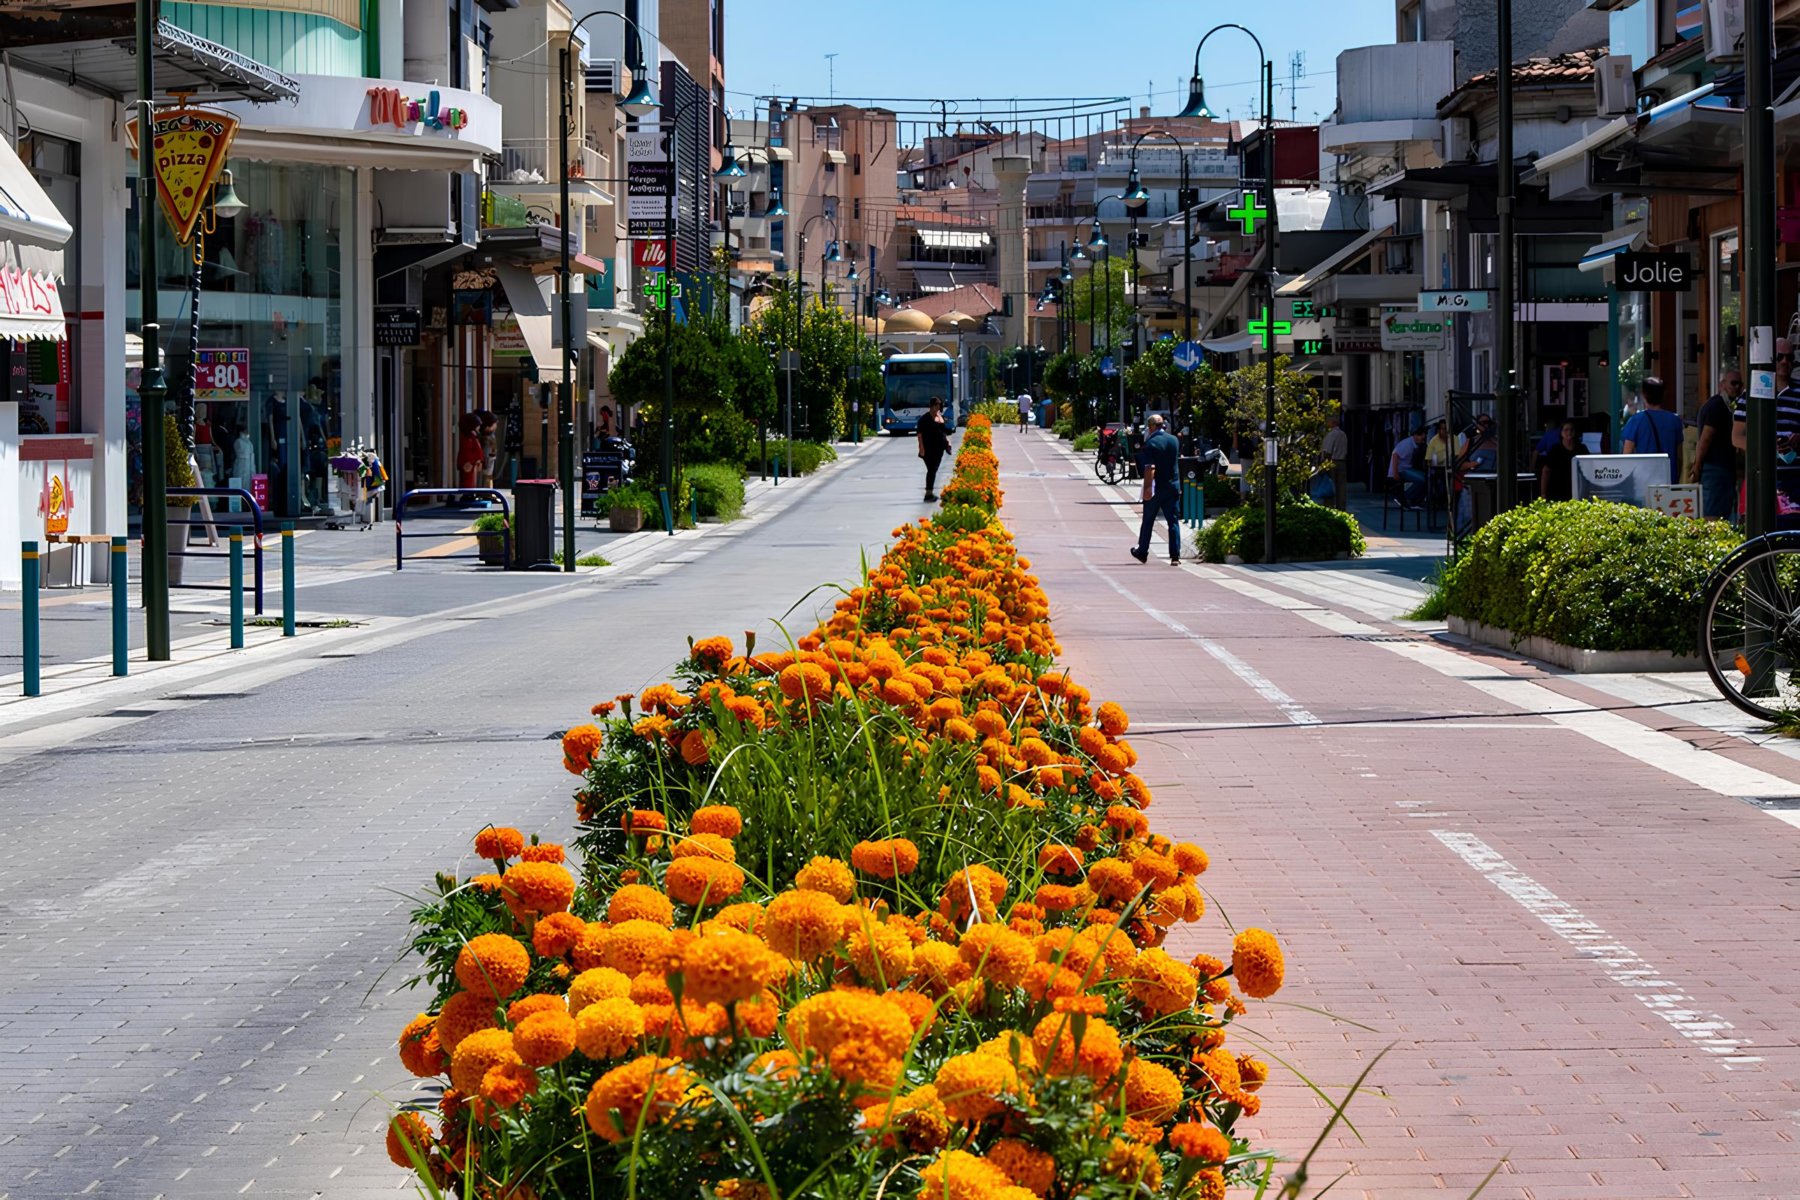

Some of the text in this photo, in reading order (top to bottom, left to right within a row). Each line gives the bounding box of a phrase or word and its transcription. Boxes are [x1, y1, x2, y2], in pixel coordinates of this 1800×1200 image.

[159, 150, 206, 172] pizza
[642, 243, 666, 266] illy
[1623, 260, 1683, 283] Jolie
